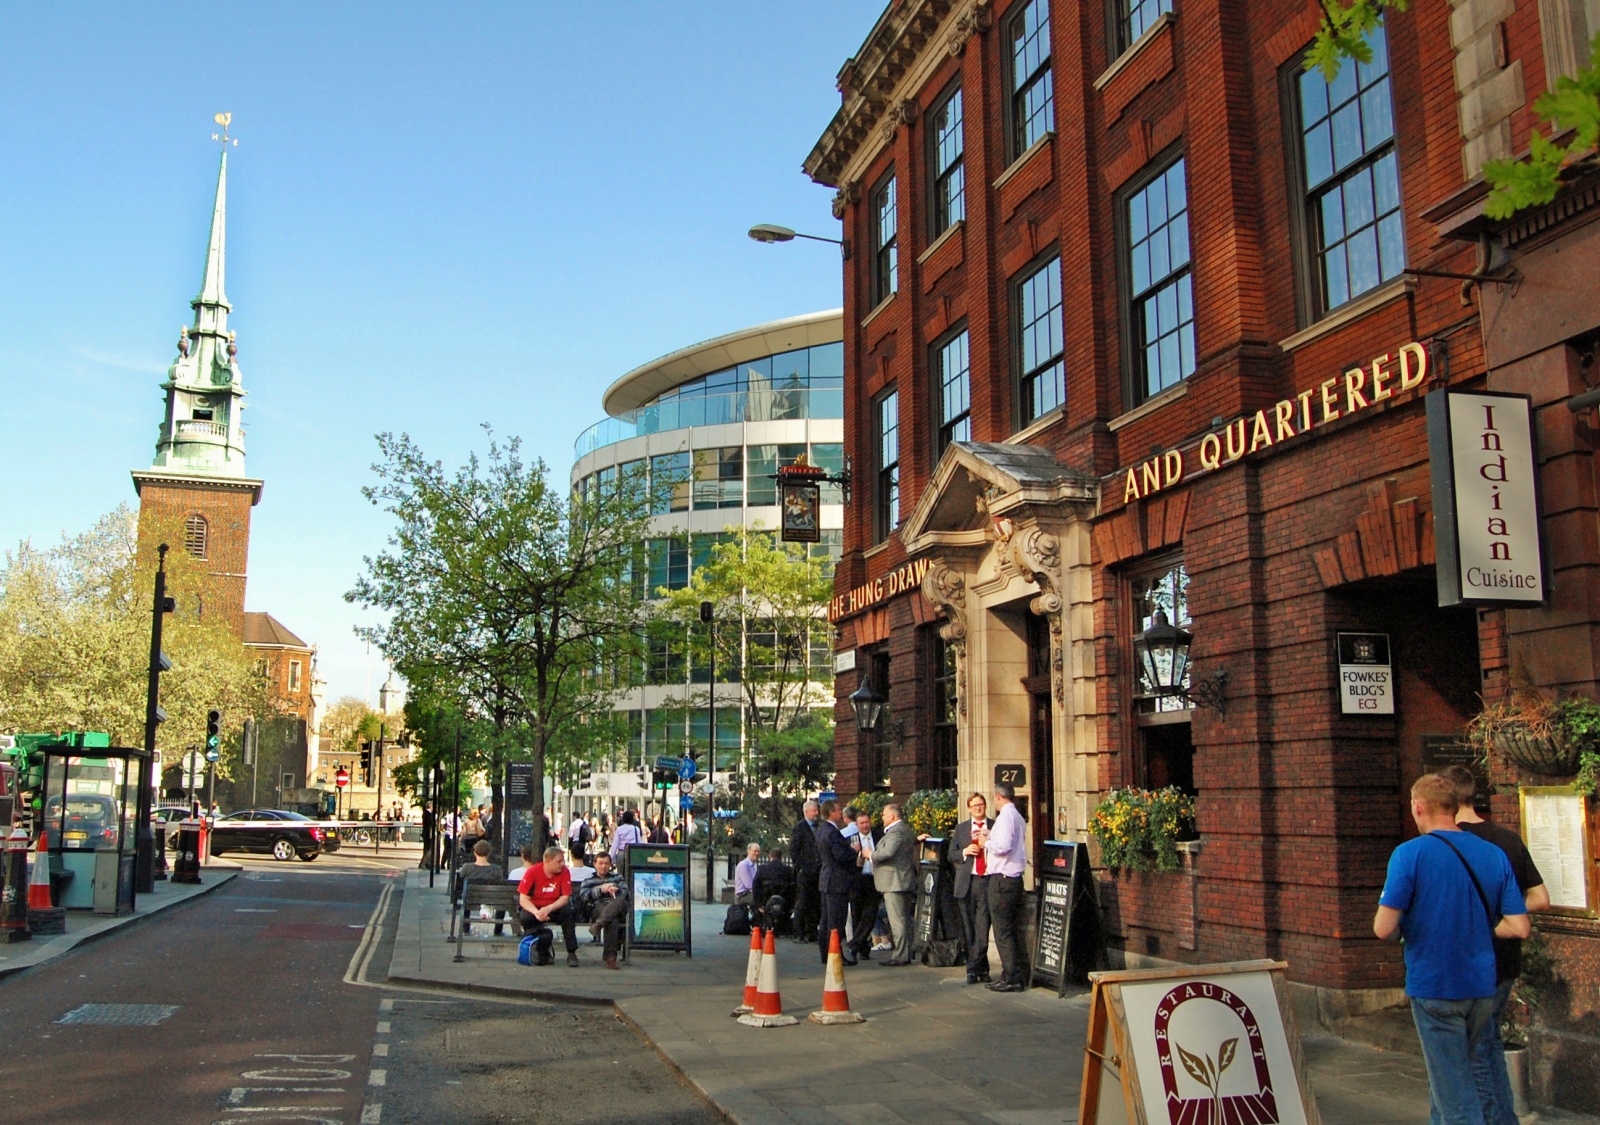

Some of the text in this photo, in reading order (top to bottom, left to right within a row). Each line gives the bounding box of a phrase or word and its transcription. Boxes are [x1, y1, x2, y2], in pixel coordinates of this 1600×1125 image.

[1124, 341, 1431, 503] AND QUARTERED
[1479, 405, 1513, 560] Indian
[1466, 567, 1537, 589] Cuisine
[827, 558, 935, 621] THE HUNG DRAW
[1342, 671, 1389, 683] FOWKES'
[1349, 685, 1385, 696] BLDG'S
[1358, 698, 1378, 710] EC3
[1001, 770, 1018, 782] 27
[636, 886, 680, 898] SPRING
[641, 898, 676, 909] MENU
[1155, 983, 1266, 1068] RESTAURANT
